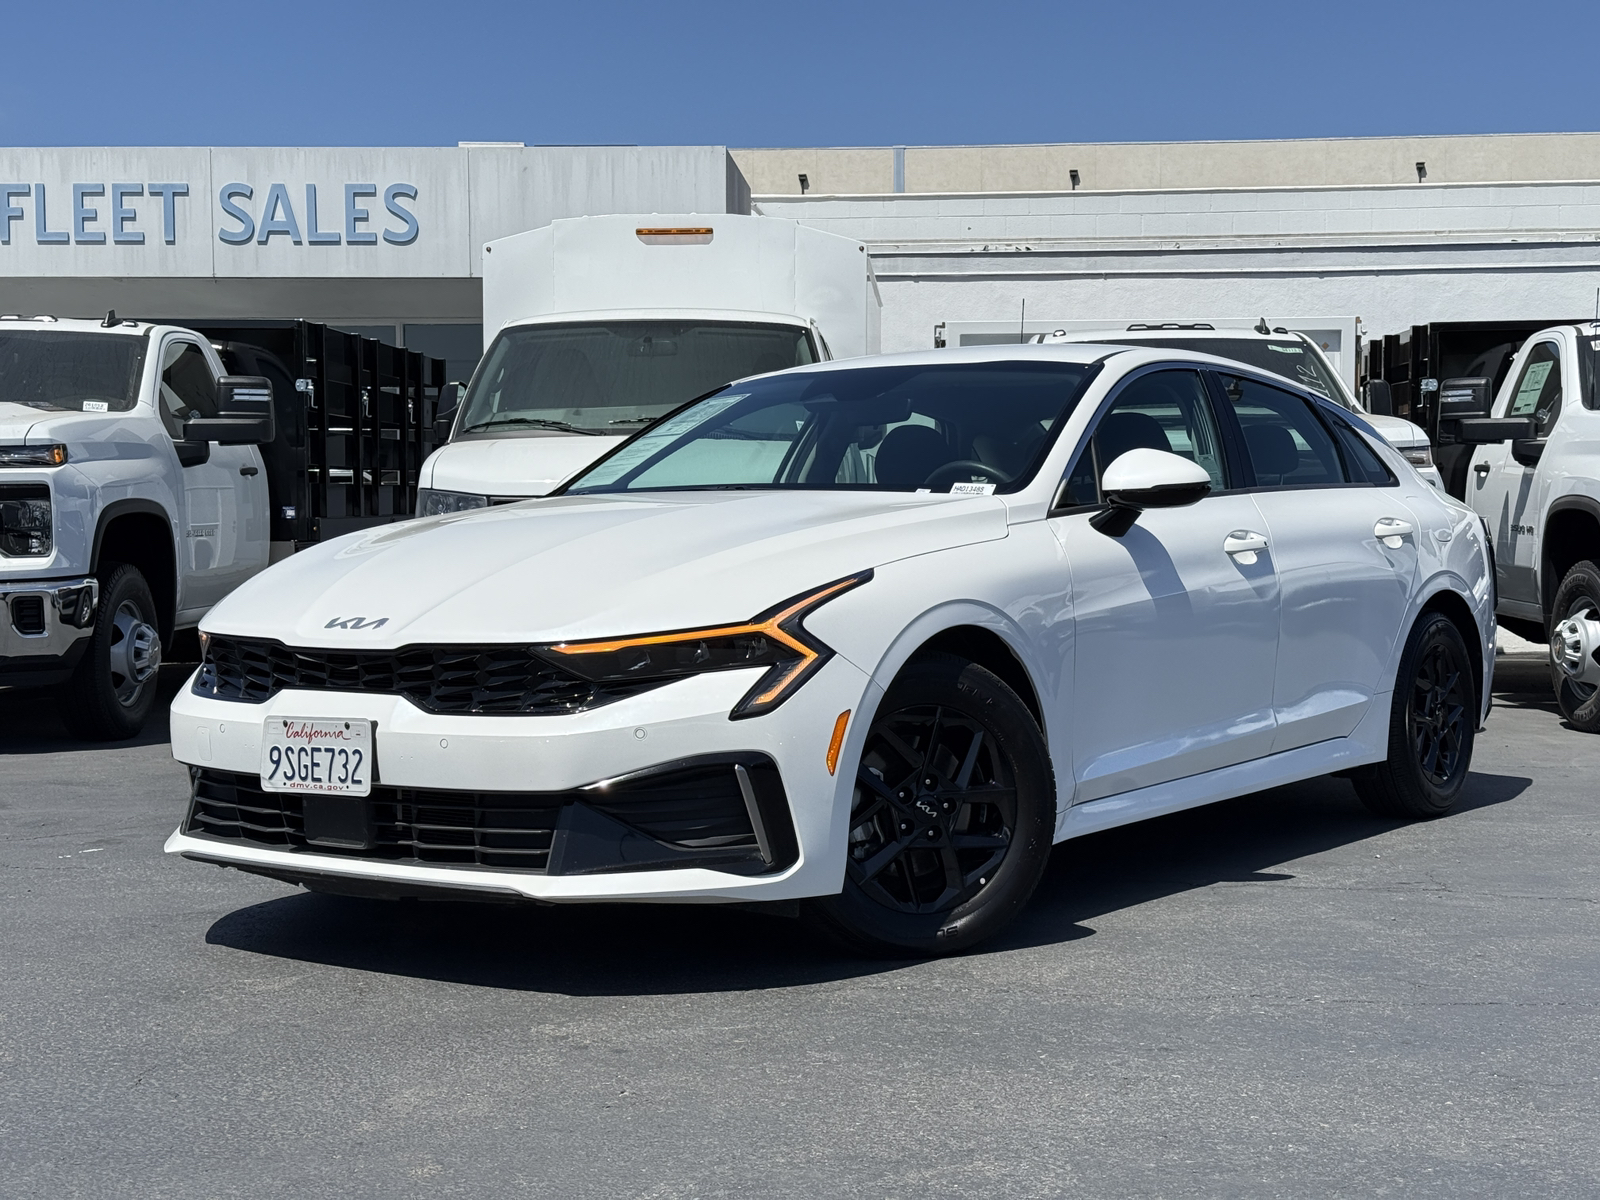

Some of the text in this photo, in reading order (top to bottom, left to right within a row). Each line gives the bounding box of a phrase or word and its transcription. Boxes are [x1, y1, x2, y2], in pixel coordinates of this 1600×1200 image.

[0, 182, 420, 246] FLEET SALES
[324, 616, 390, 630] KIA
[285, 721, 351, 745] California
[267, 745, 363, 785] 9SGE732
[289, 782, 344, 791] dmv.ca.gov
